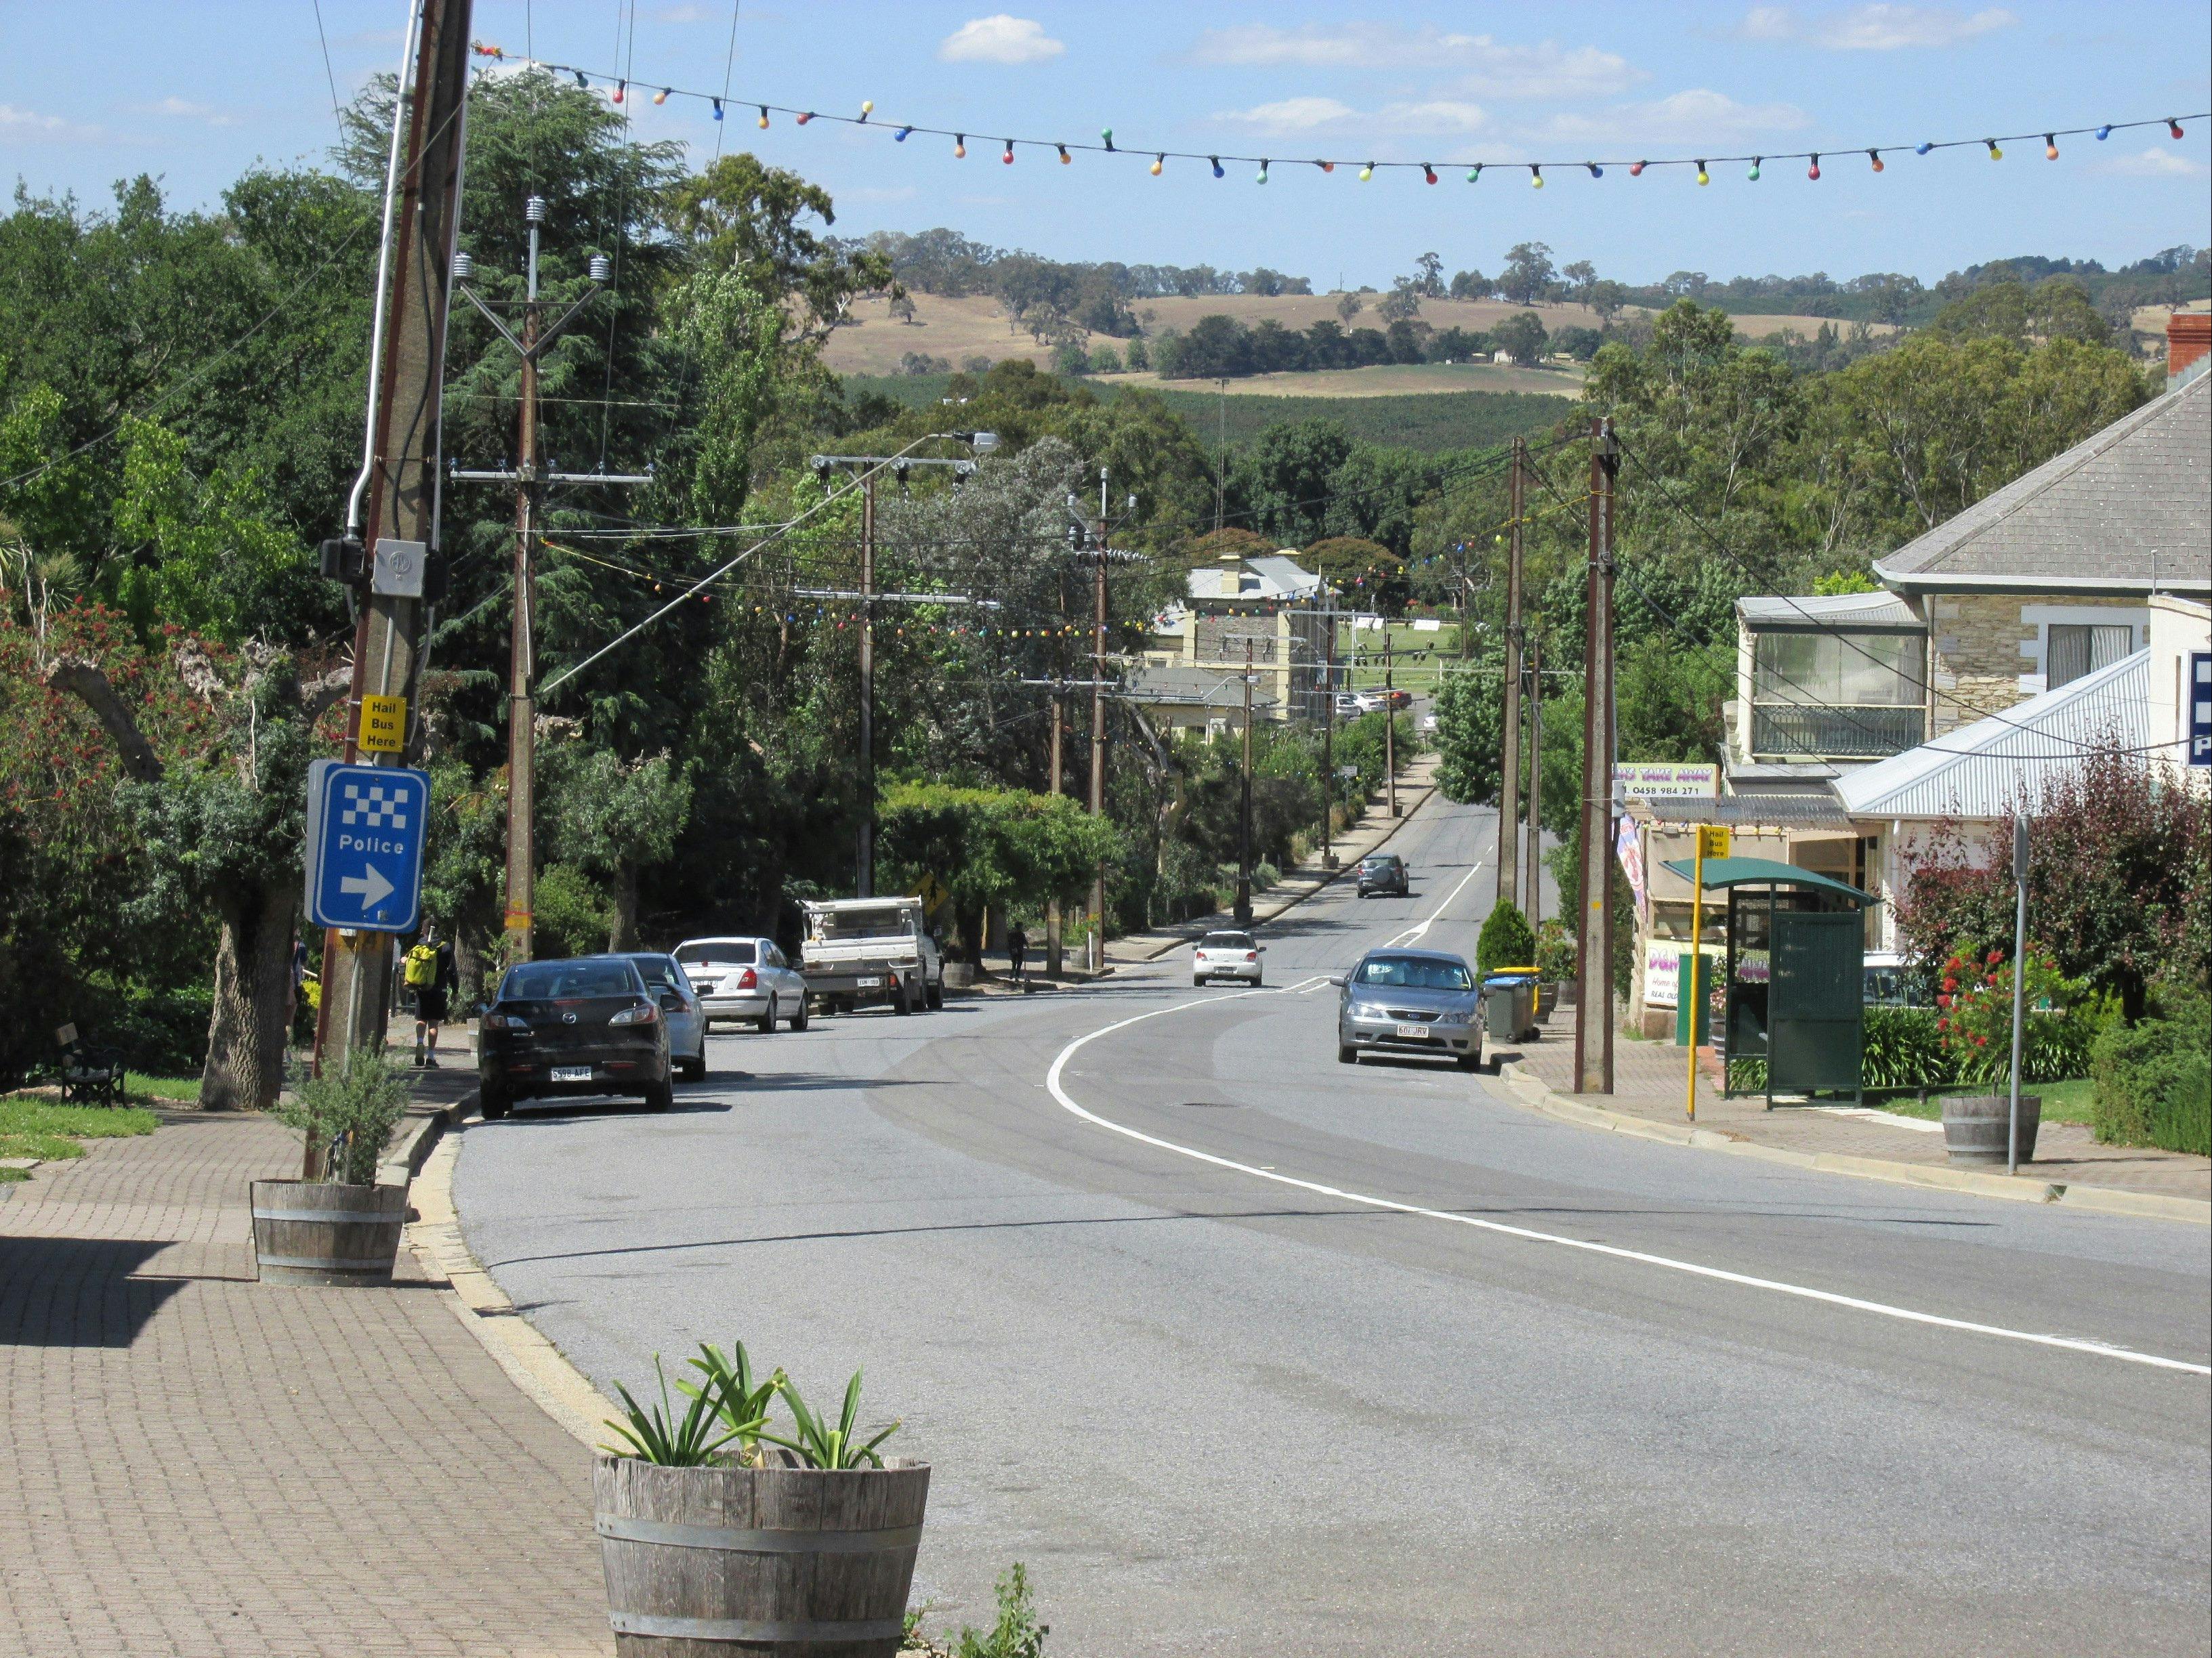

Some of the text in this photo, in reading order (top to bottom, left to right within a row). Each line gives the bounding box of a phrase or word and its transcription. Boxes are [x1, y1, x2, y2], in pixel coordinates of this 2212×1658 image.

[372, 702, 396, 713] Hail
[371, 719, 394, 729] Bus
[367, 735, 396, 746] Here
[1640, 768, 1673, 782] TAKE
[1677, 768, 1713, 782] AWAY
[1633, 786, 1656, 794] 0458
[1661, 786, 1677, 794] 984
[1682, 786, 1698, 795] 271
[339, 834, 404, 854] Police
[1652, 977, 1670, 987] Home
